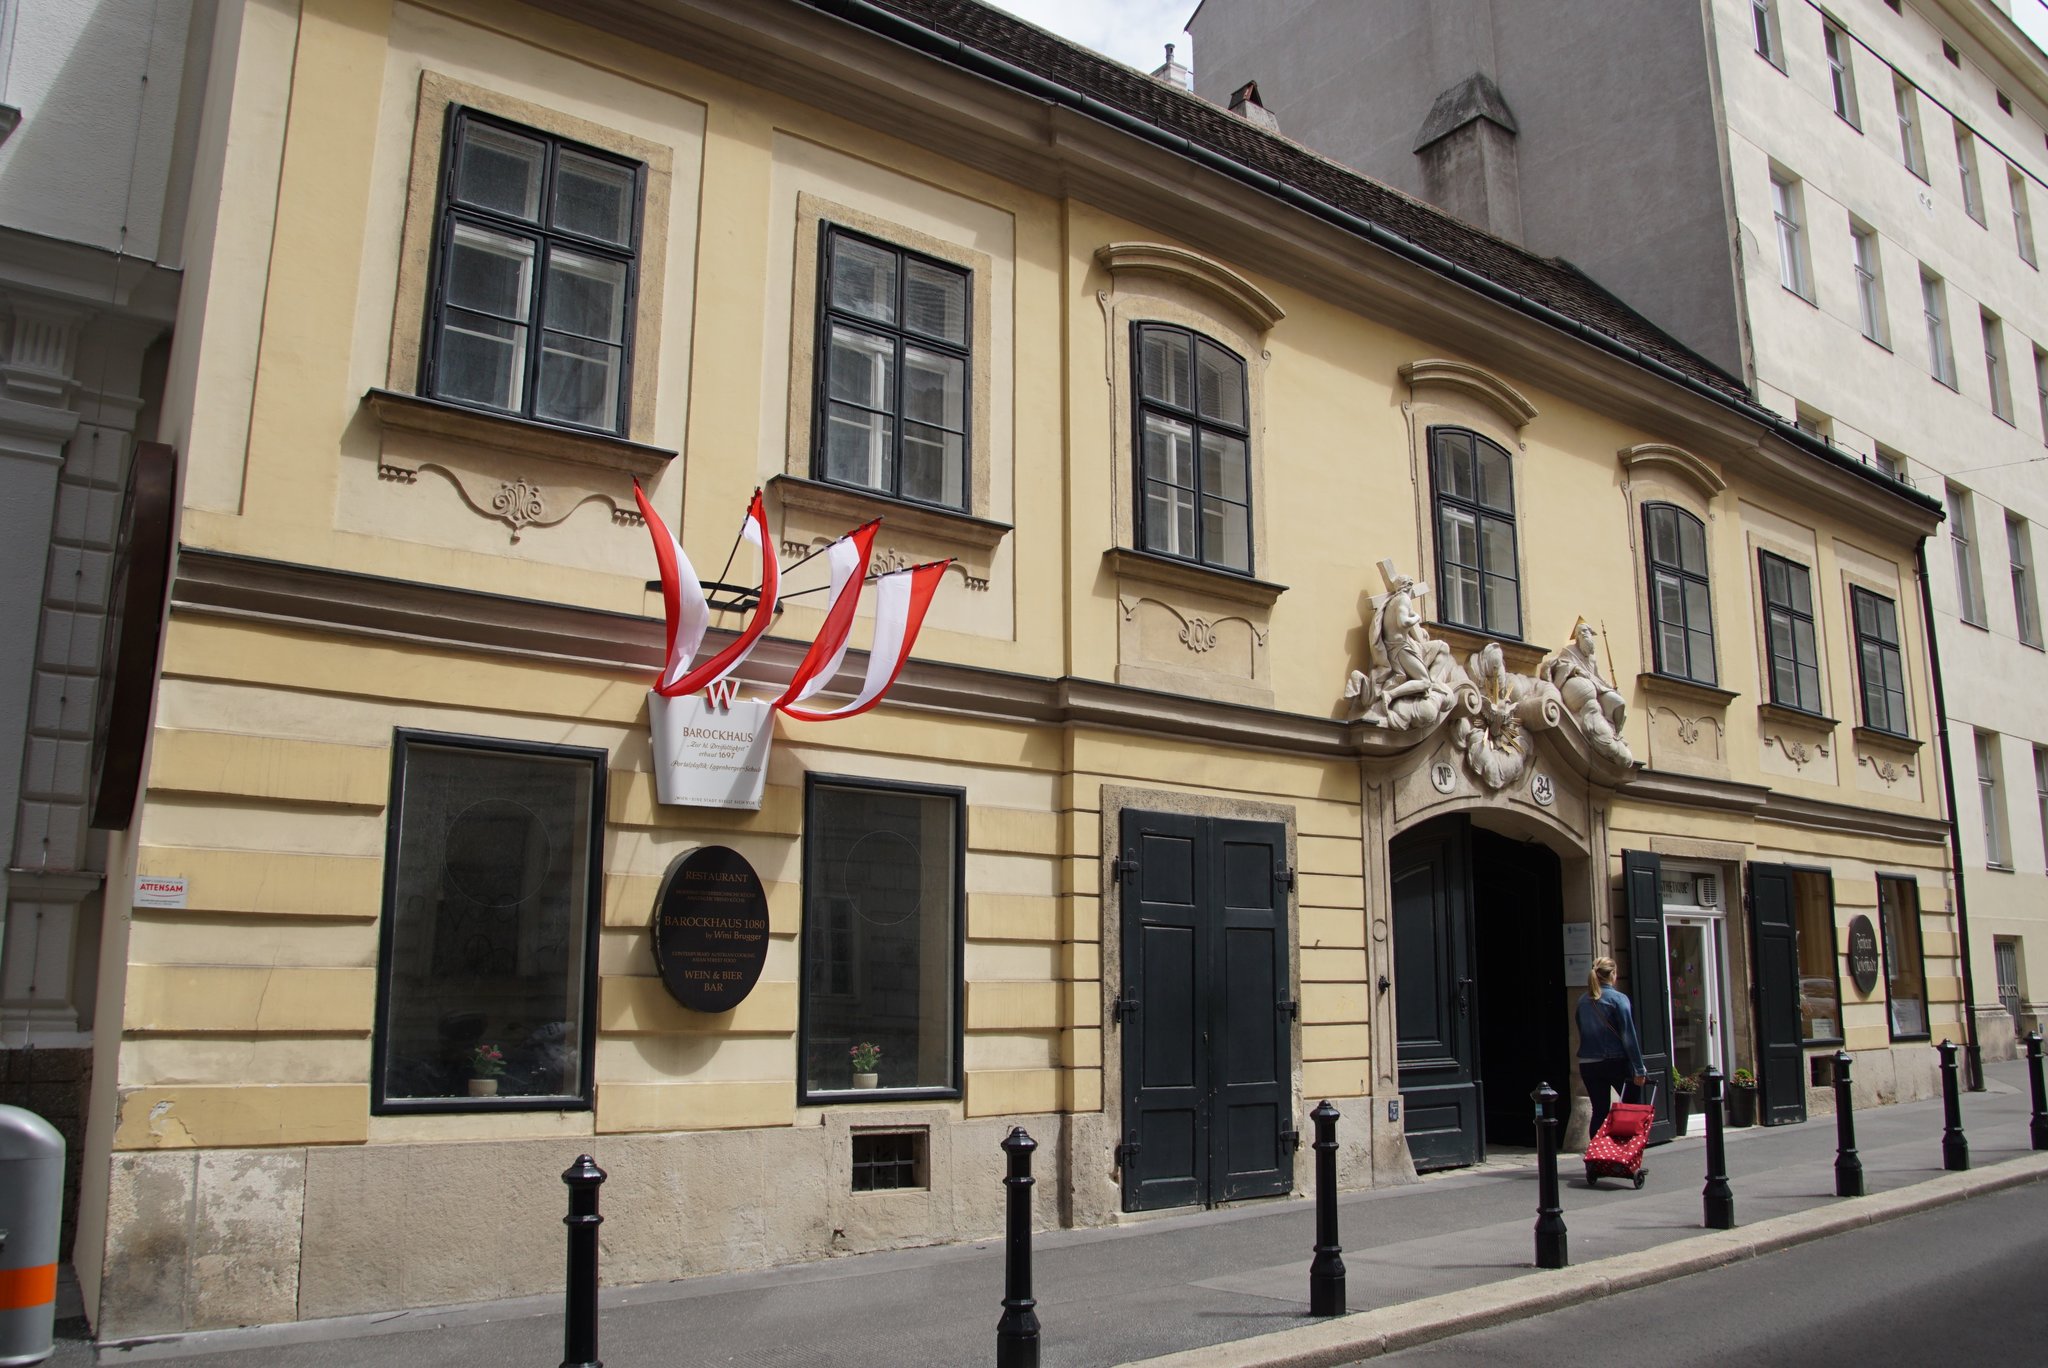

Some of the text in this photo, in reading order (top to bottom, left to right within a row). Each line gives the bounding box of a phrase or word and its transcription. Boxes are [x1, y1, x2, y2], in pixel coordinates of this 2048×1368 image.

[704, 680, 740, 710] W
[683, 727, 753, 743] BAROCKHAUS
[1537, 776, 1550, 795] 34
[685, 870, 749, 883] RESTAURANT
[140, 883, 183, 893] ATTENSAM
[664, 916, 765, 930] BAROCKHAUS 1080
[705, 930, 762, 942] by Wini Brugger
[684, 969, 743, 980] WEIN & BIER
[704, 983, 724, 992] BAR
